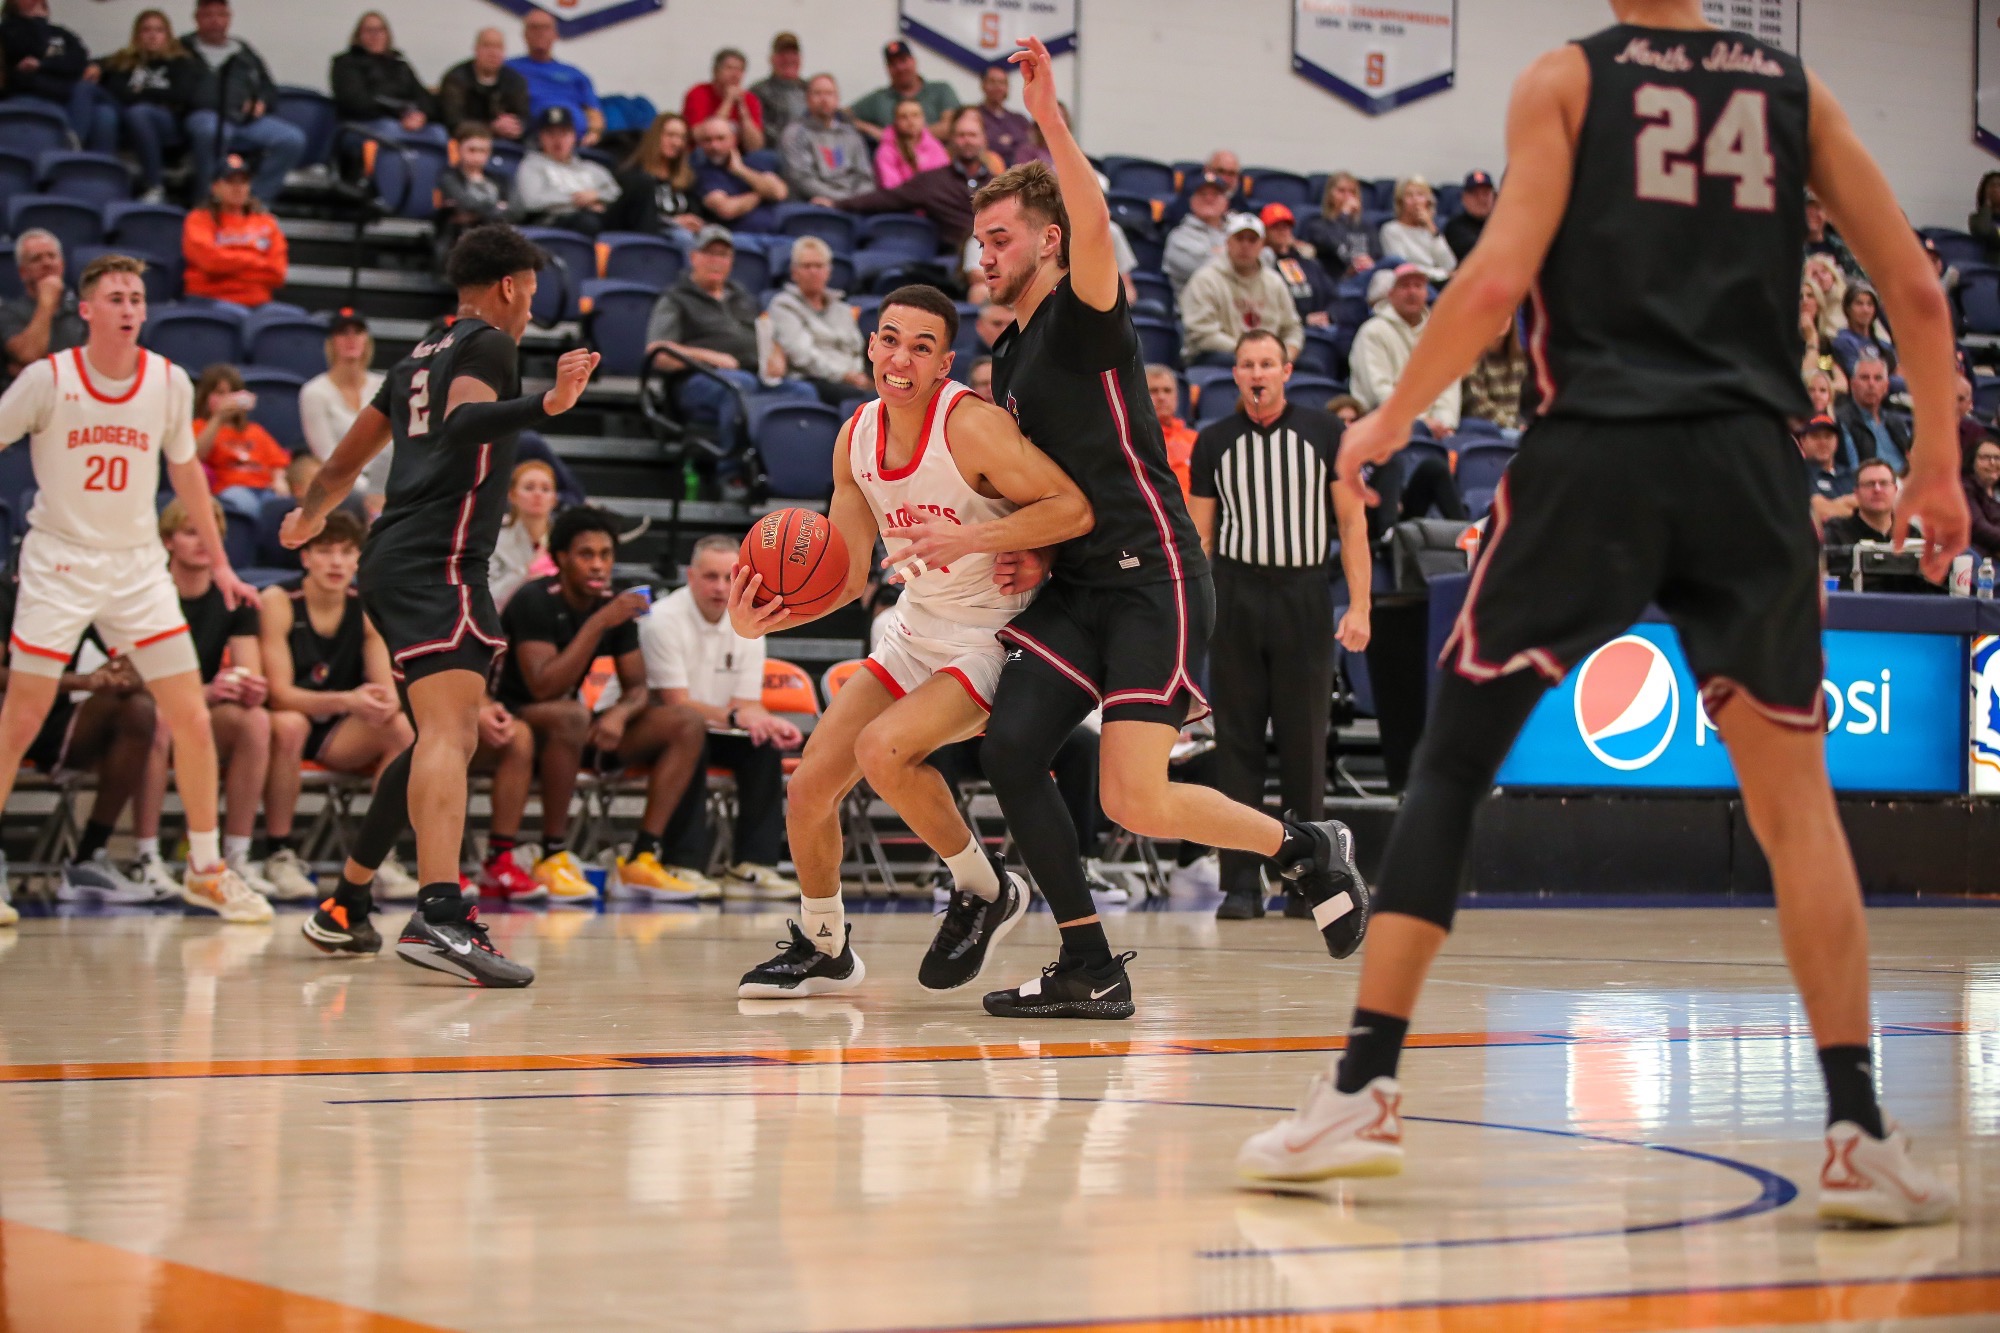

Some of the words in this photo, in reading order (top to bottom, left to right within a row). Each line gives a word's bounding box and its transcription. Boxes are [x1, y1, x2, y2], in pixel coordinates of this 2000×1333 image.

[1365, 52, 1386, 89] S
[1614, 37, 1694, 72] North
[1633, 82, 1776, 212] 24
[408, 368, 430, 438] 2
[67, 424, 151, 452] BADGERS
[84, 455, 130, 492] 20
